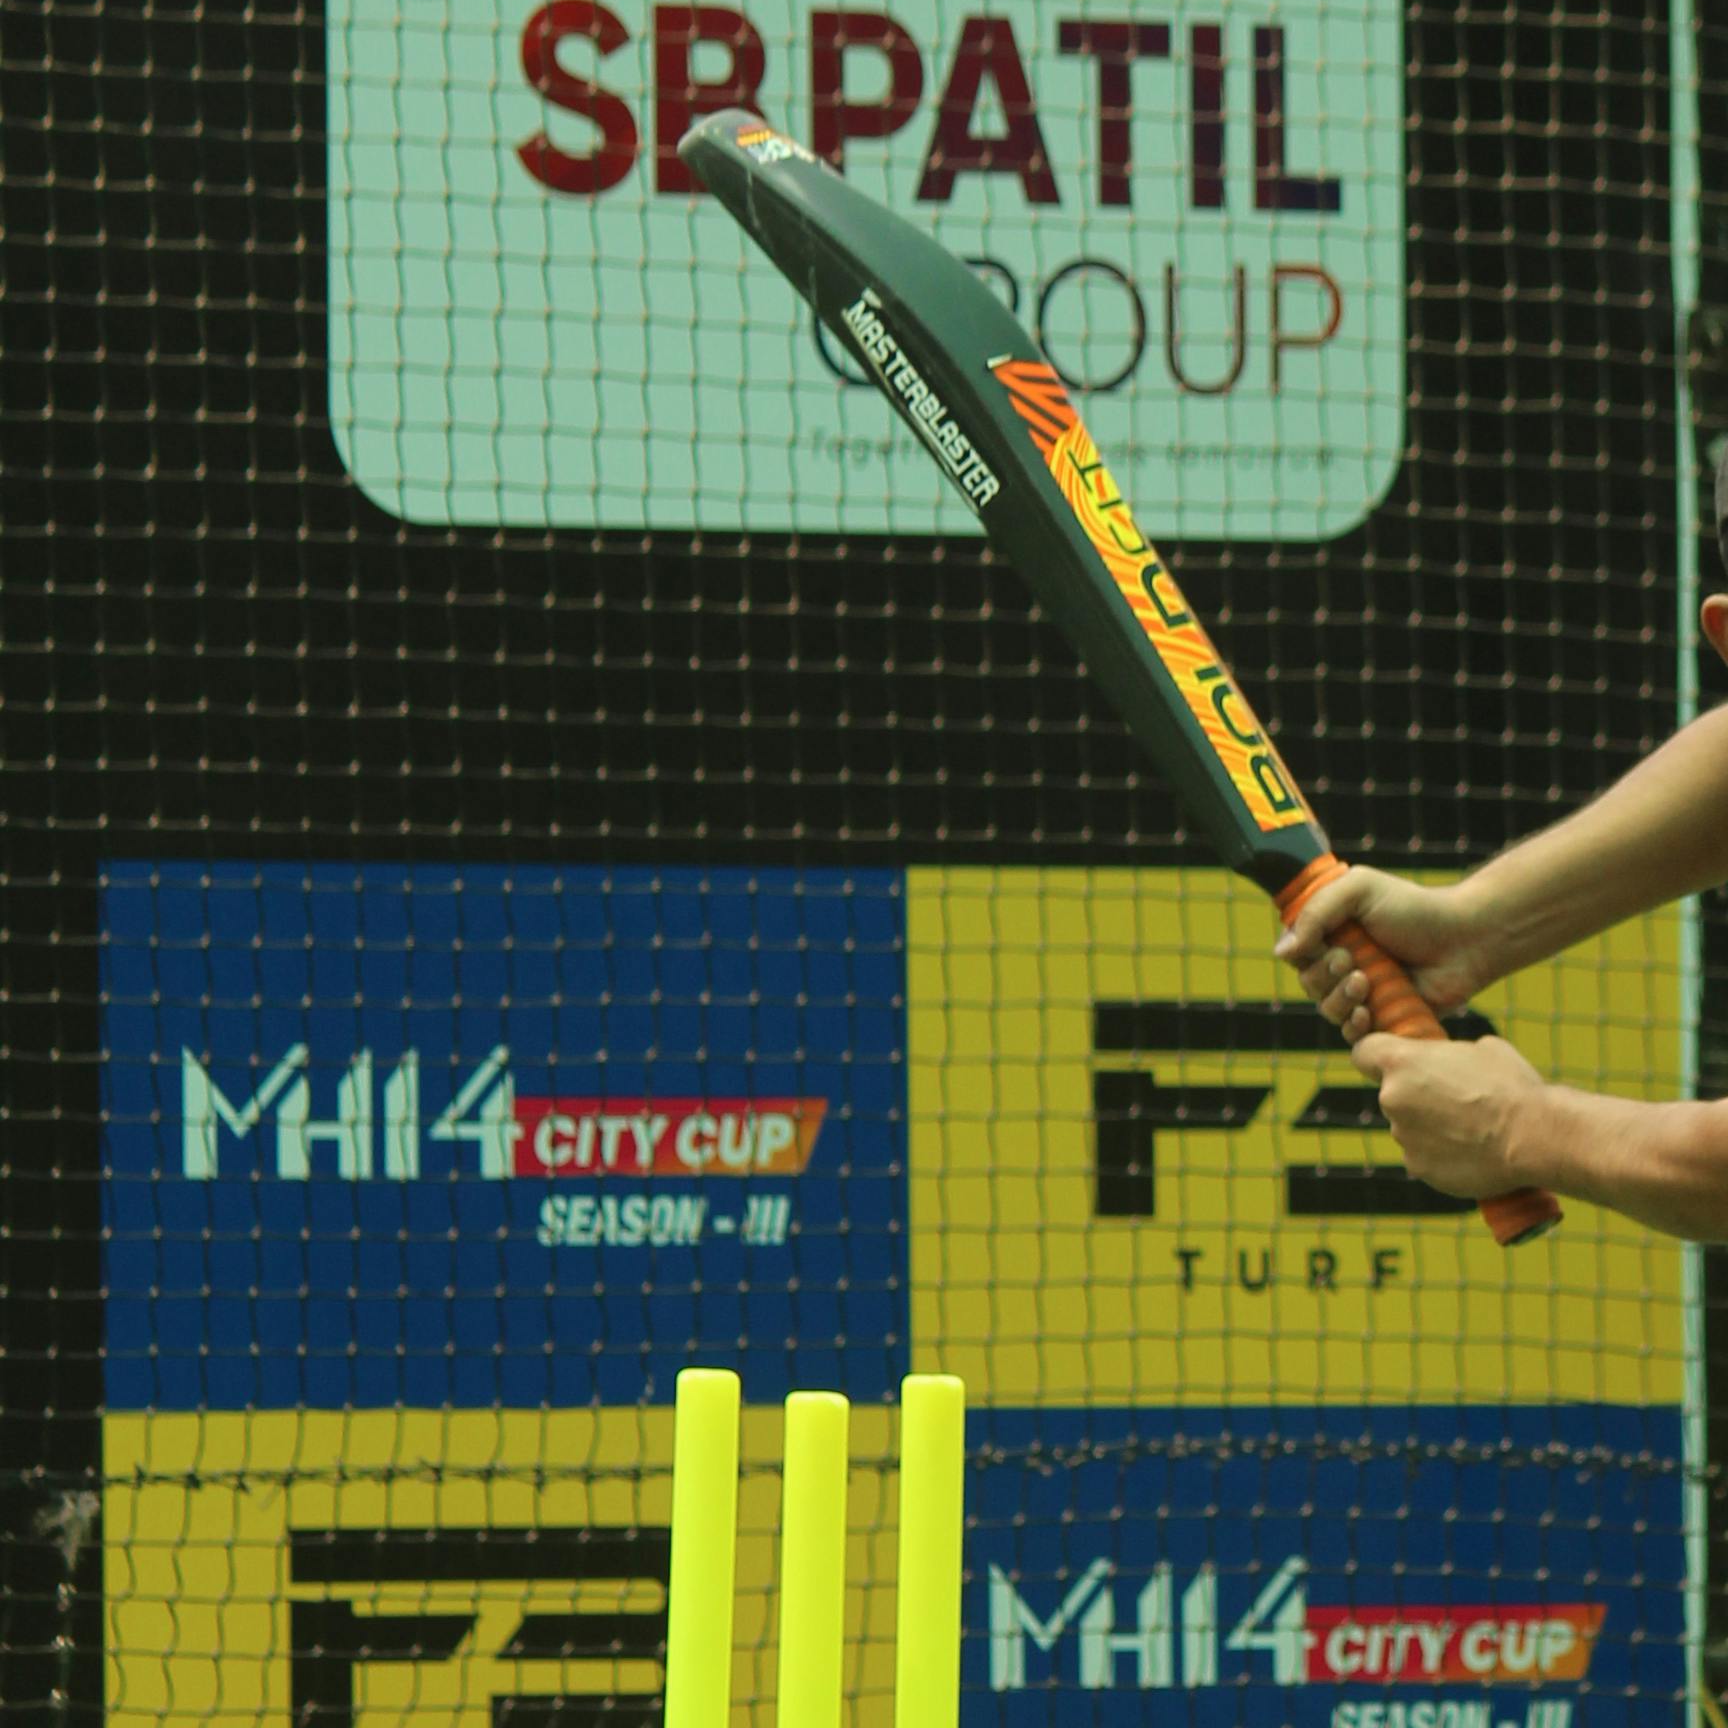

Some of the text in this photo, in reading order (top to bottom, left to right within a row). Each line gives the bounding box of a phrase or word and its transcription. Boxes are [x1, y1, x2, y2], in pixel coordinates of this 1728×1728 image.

[808, 9, 1341, 211] PATIL
[182, 1043, 795, 1180] MH14 CITY CUP
[537, 1194, 706, 1246] SEASON
[741, 1194, 790, 1245] III
[1173, 1251, 1403, 1291] TURF
[988, 1557, 1575, 1690] MH14 CITY CUP
